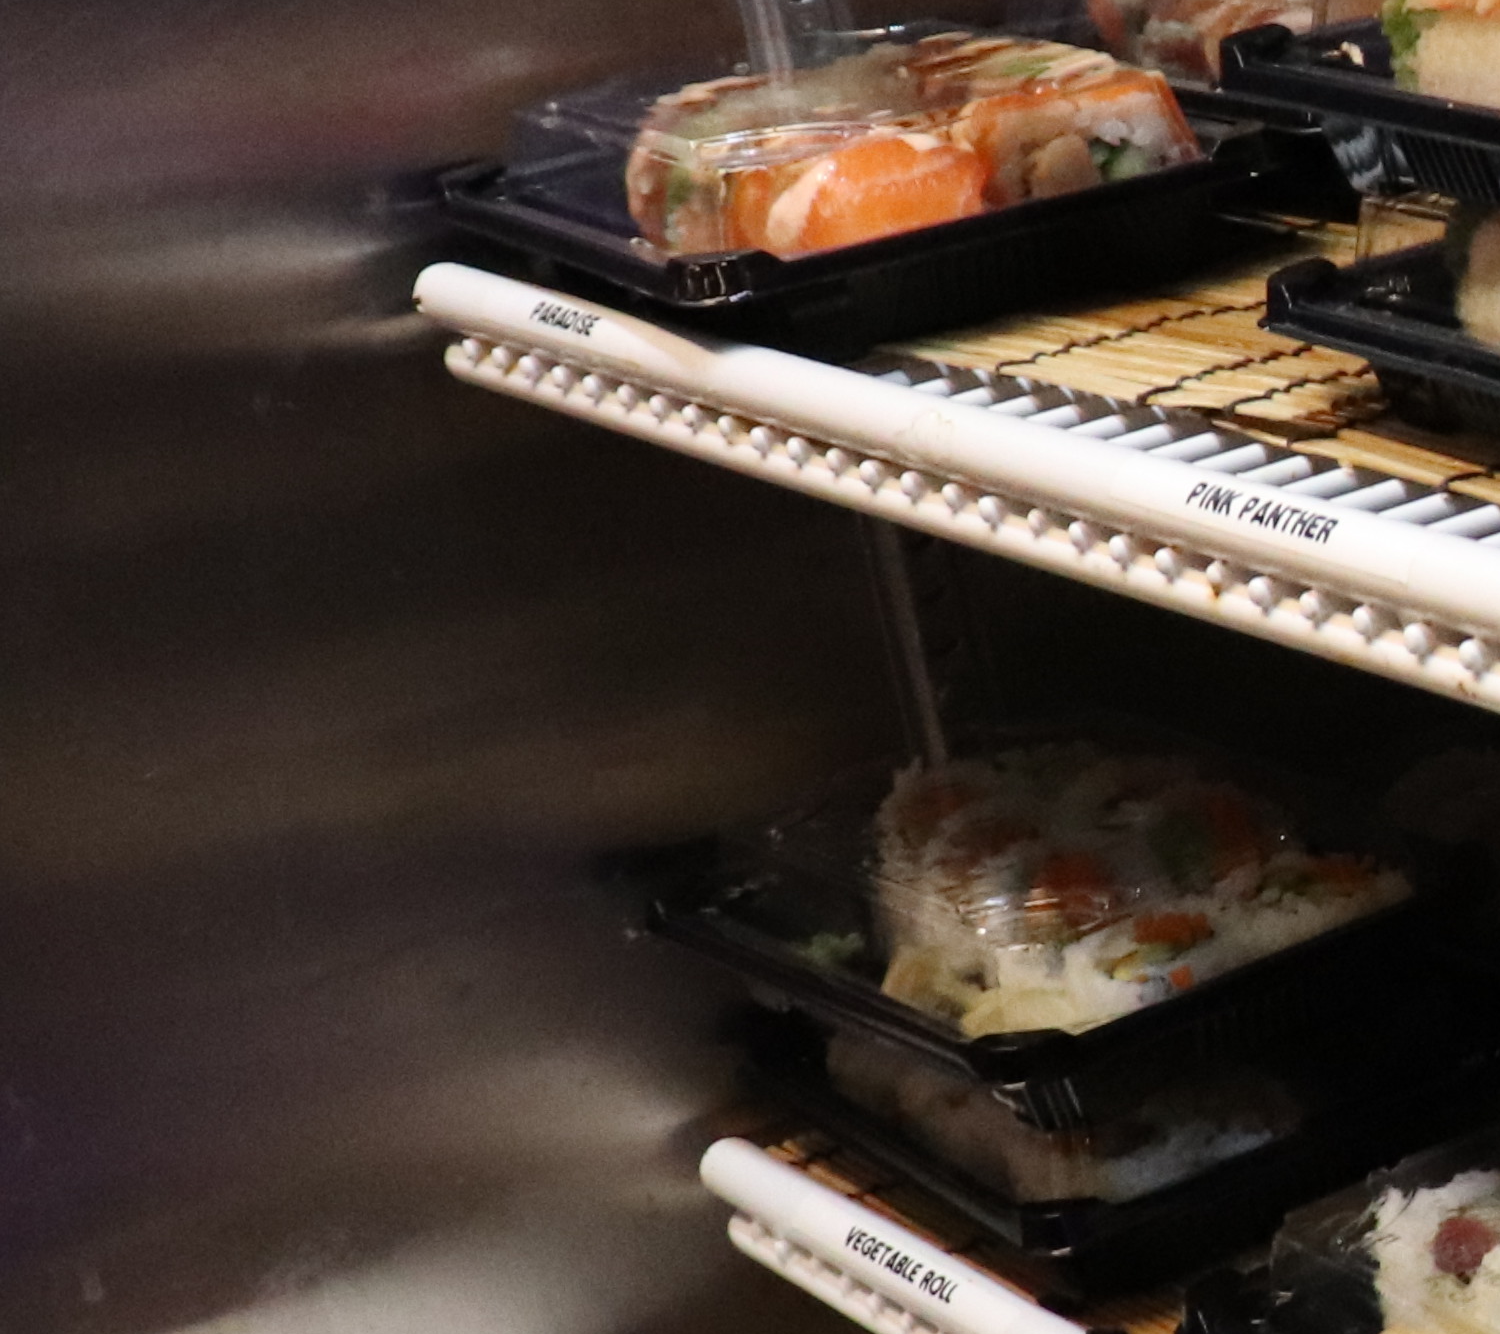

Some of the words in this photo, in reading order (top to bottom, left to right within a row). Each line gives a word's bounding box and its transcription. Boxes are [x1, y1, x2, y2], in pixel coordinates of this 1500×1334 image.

[530, 301, 600, 336] PARADISE
[1186, 482, 1242, 516] PINK
[1239, 496, 1338, 544] PANTHER
[845, 1226, 921, 1283] VEGETABLE
[919, 1270, 958, 1304] ROLL
